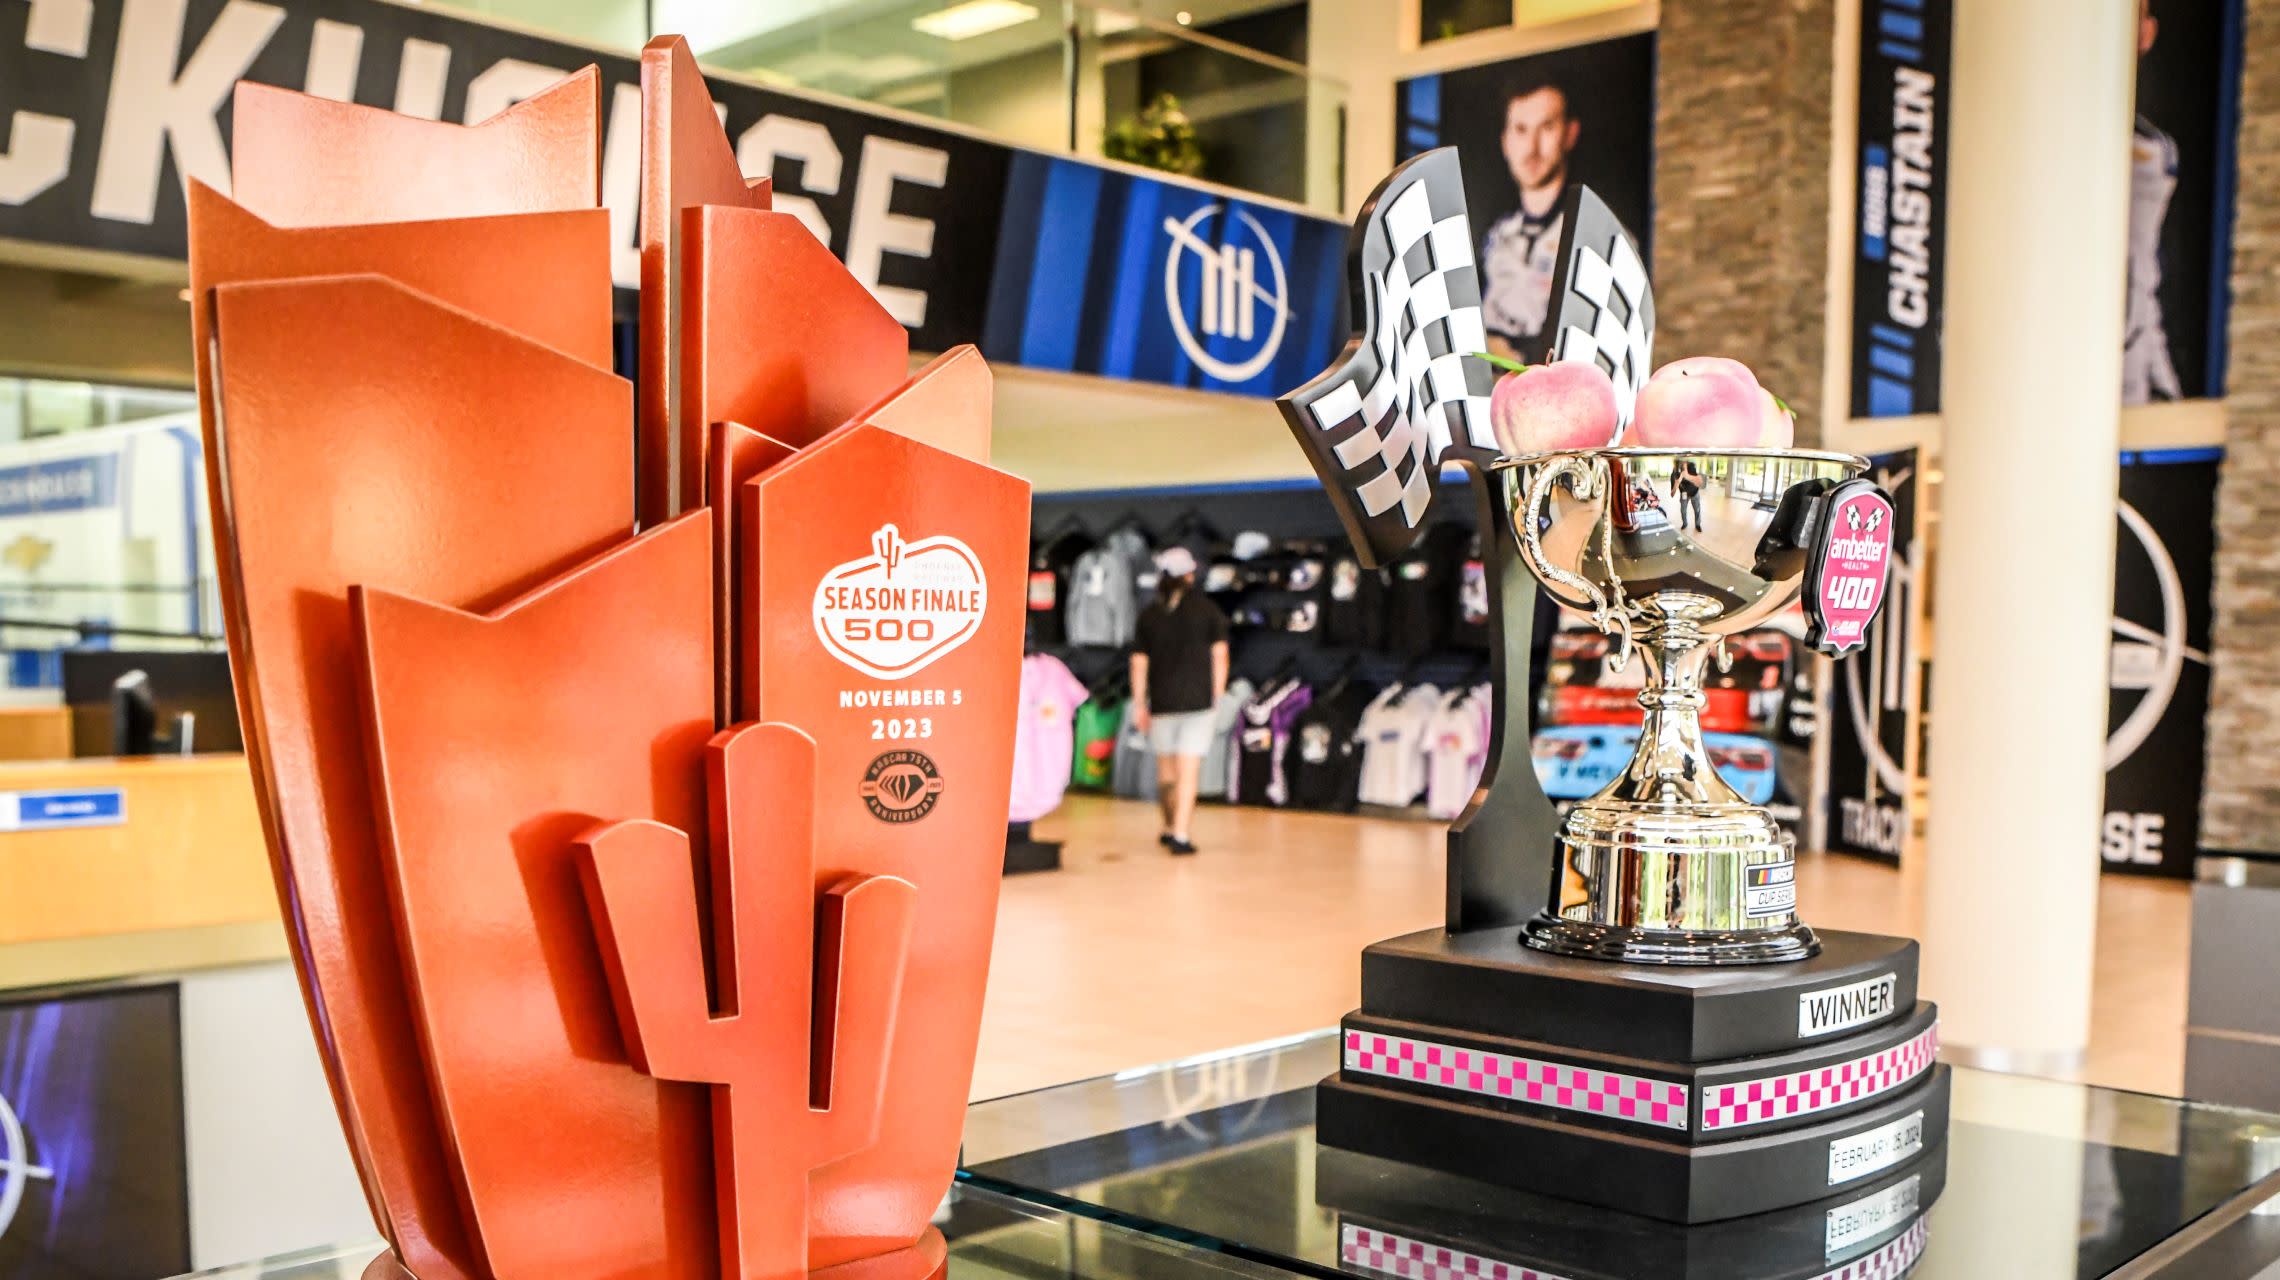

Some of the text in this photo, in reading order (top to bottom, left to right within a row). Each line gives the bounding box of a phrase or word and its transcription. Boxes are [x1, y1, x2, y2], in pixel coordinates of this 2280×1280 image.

[1887, 66, 1935, 328] CHASTAIN
[1831, 533, 1885, 561] ambetter
[825, 586, 979, 612] SEASON FINALE
[1827, 576, 1877, 609] 400
[845, 618, 934, 641] 500
[840, 689, 963, 708] NOVEMBER 5
[871, 718, 933, 740] 2023
[871, 752, 933, 776] NASCAR 75TH
[869, 796, 934, 822] ANNIVERSARY
[1758, 891, 1776, 905] CUP
[1810, 982, 1889, 1029] WINNER
[1834, 1139, 1889, 1169] FEBRUARY
